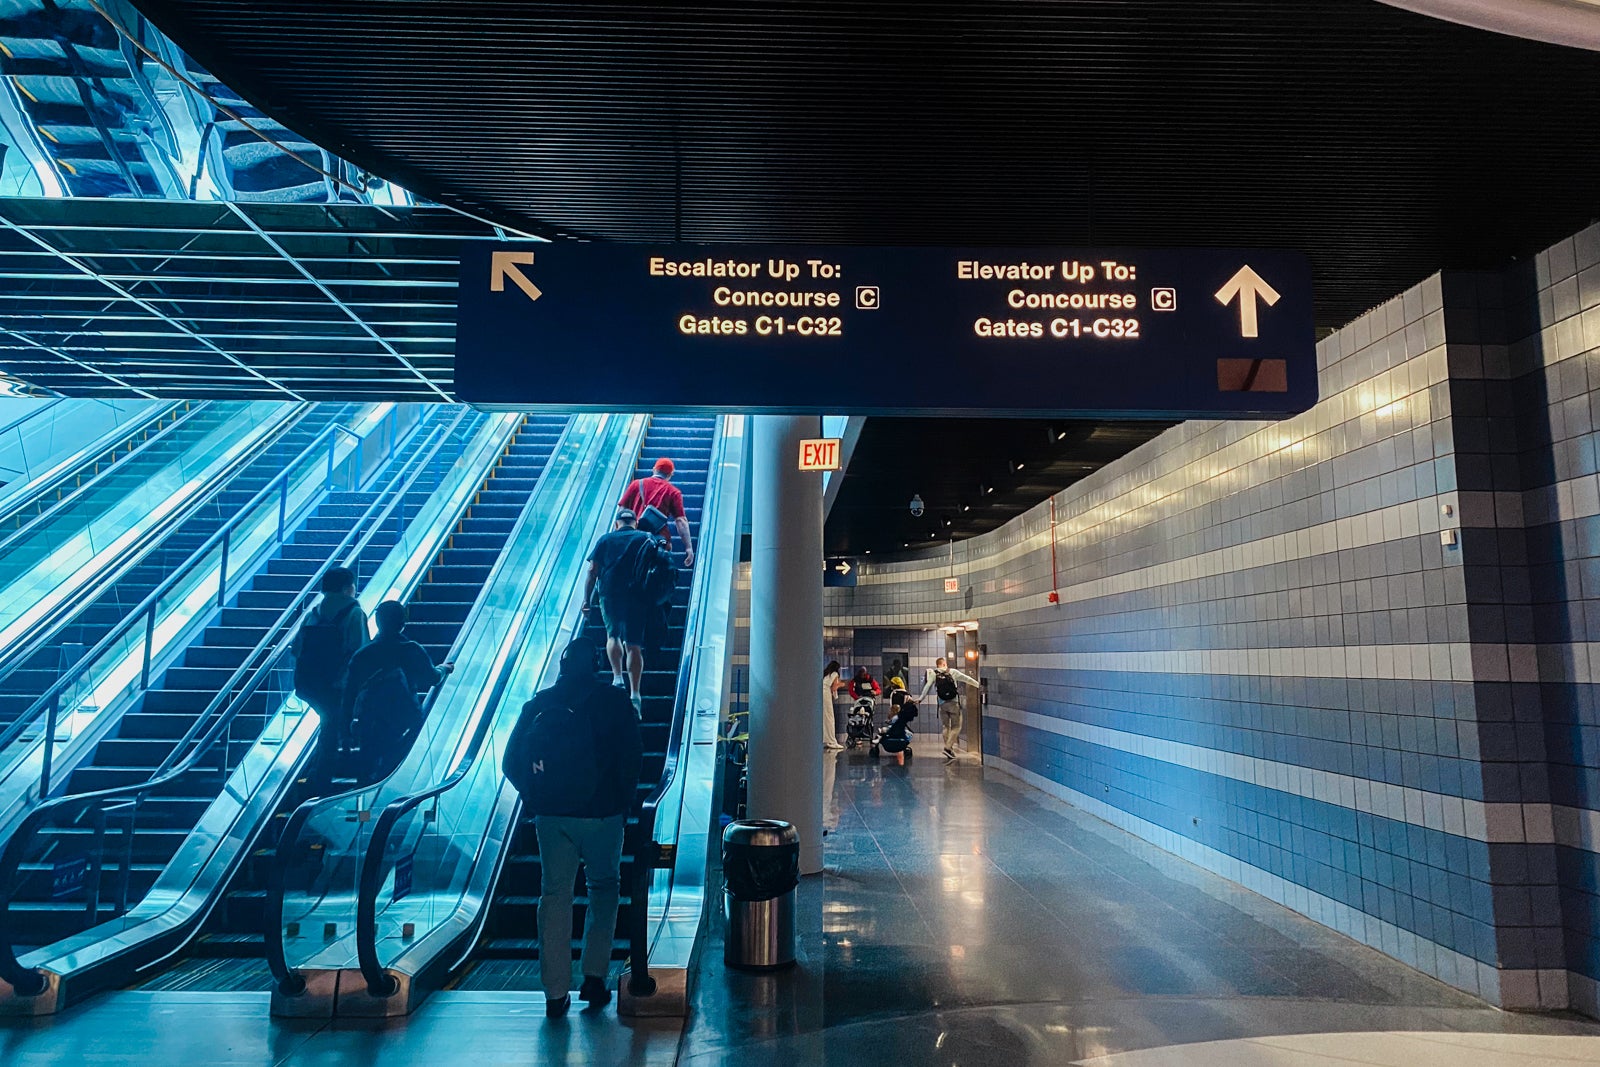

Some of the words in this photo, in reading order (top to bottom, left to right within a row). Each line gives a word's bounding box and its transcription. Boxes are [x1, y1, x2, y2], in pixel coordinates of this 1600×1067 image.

[649, 257, 761, 278] Escalator
[768, 259, 800, 282] Up
[806, 259, 841, 279] To:
[957, 260, 1055, 280] Elevator
[1061, 260, 1095, 284] Up
[1100, 261, 1136, 281] To:
[713, 286, 841, 307] Concourse
[858, 288, 877, 308] C
[1007, 289, 1137, 309] Concourse
[1154, 289, 1173, 309] C
[679, 314, 748, 335] Gates
[755, 315, 842, 336] C1-C32
[974, 317, 1044, 338] Gates
[1050, 317, 1140, 338] C1-C32
[803, 443, 836, 466] EXIT
